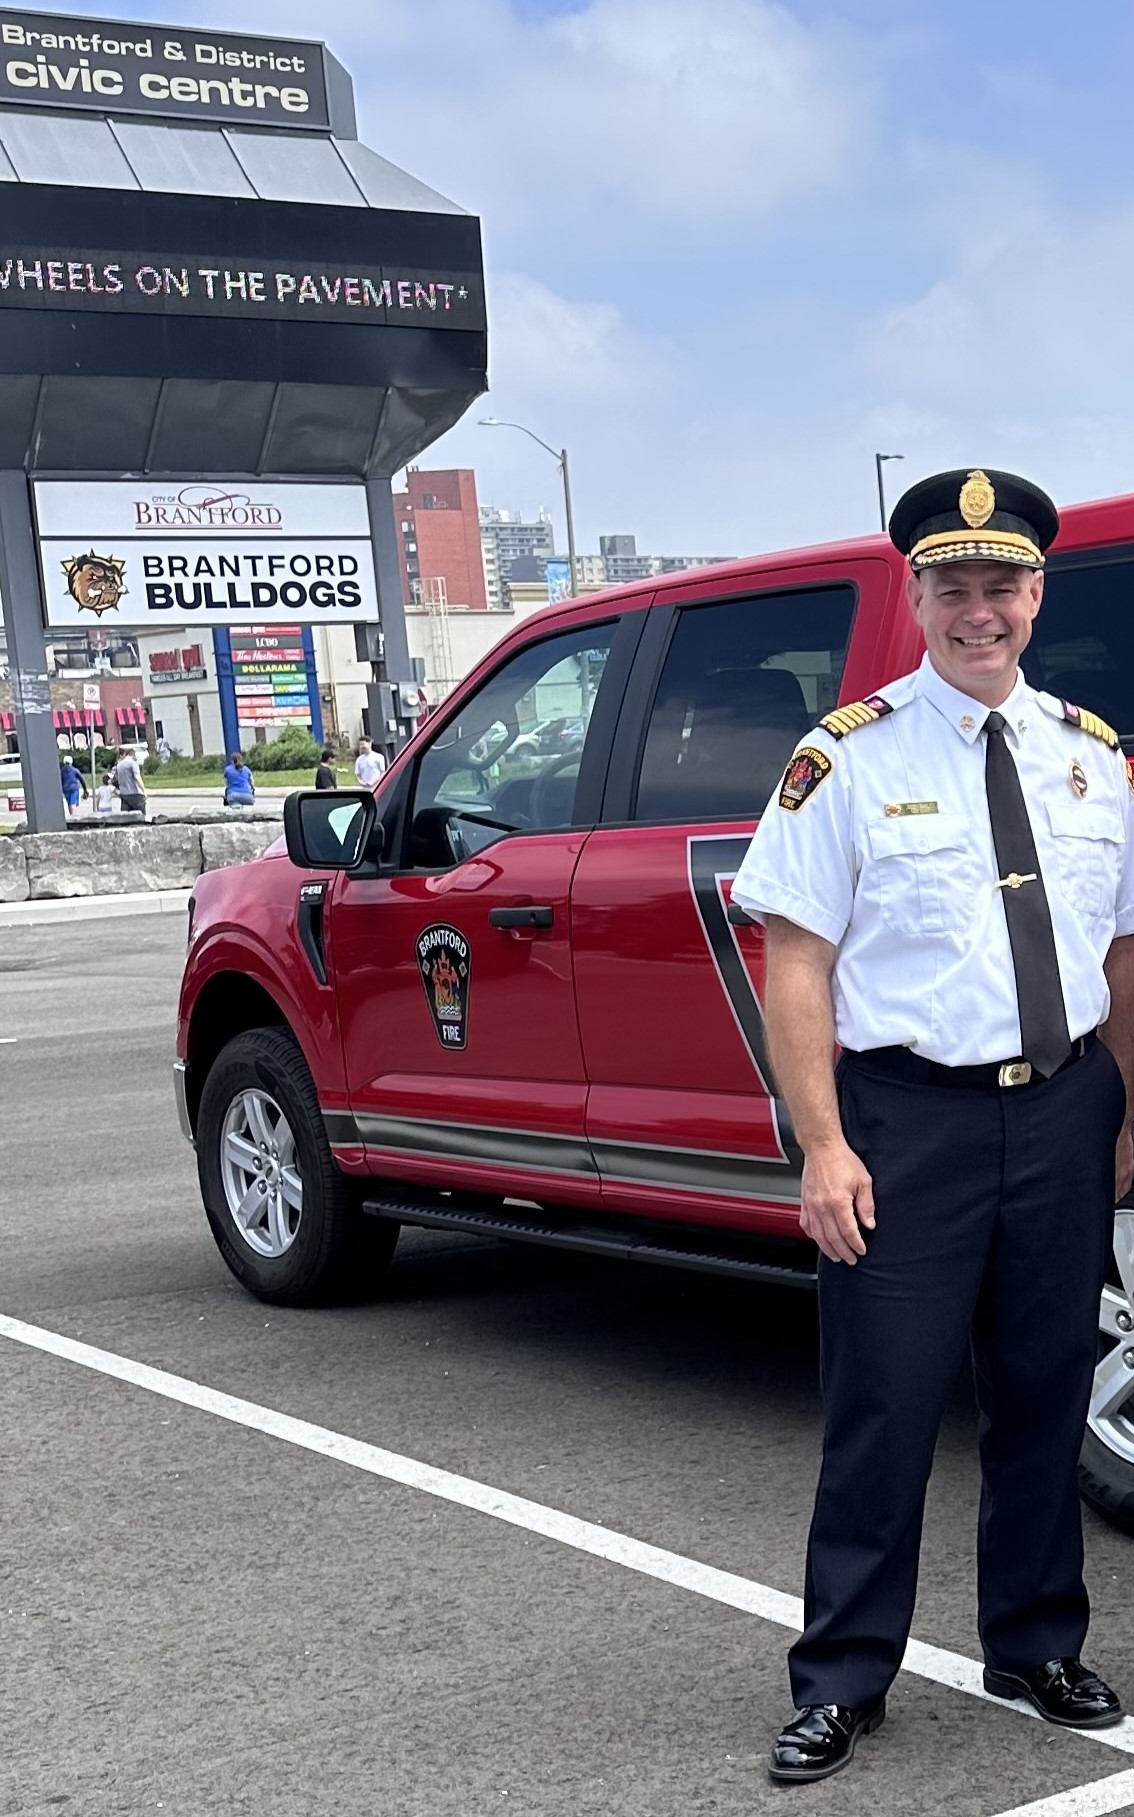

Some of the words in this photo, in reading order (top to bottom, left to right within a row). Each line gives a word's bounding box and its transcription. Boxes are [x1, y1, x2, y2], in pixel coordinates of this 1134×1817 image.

[2, 24, 152, 59] Brantford
[164, 42, 187, 62] &
[195, 44, 305, 73] District
[6, 55, 123, 96] civic
[139, 73, 309, 113] centre
[136, 266, 190, 297] ON
[198, 269, 268, 302] THE
[133, 501, 282, 525] BRANTFORD
[143, 555, 359, 578] BRANTFORD
[146, 581, 362, 610] BULLDOGS
[241, 664, 298, 673] DOLLARAMA
[419, 930, 467, 957] BRANTFORD
[442, 1024, 461, 1042] FIRE
